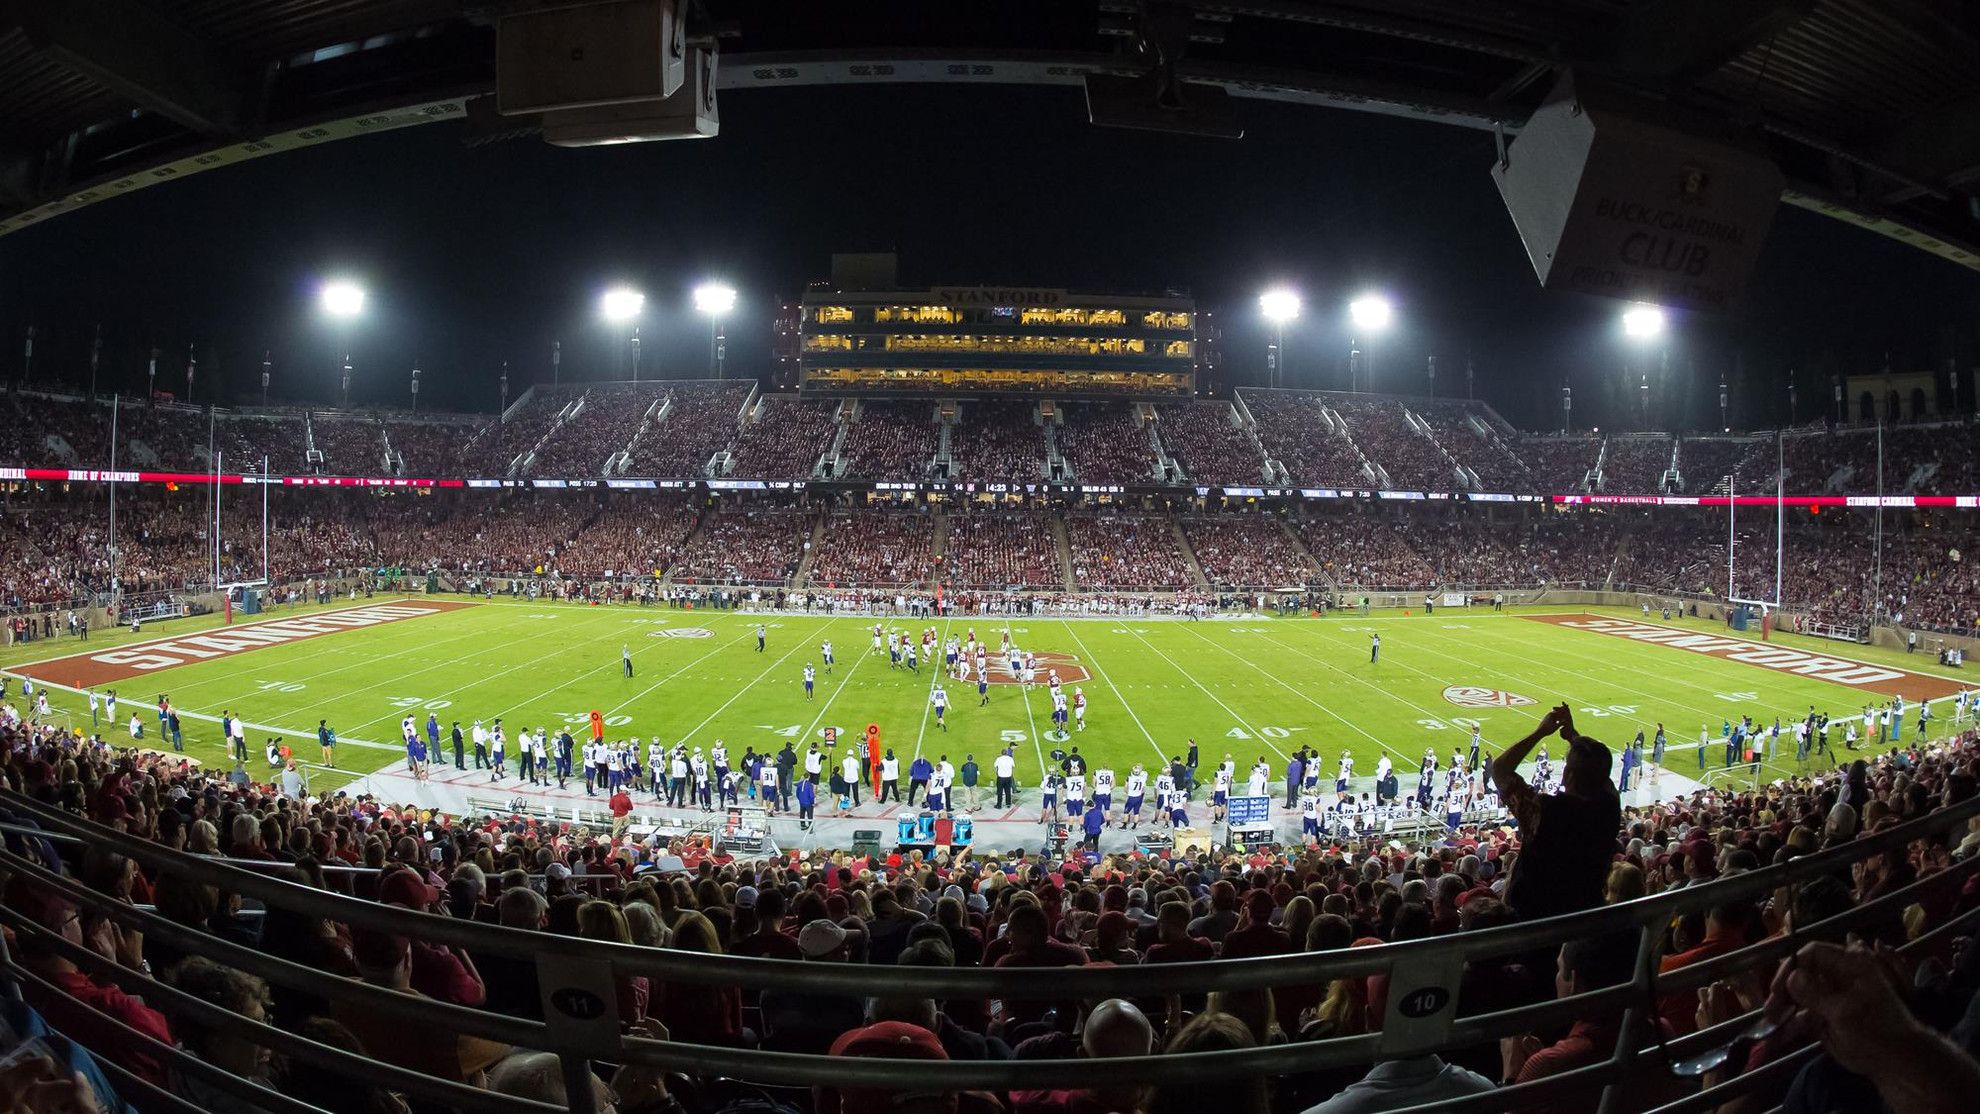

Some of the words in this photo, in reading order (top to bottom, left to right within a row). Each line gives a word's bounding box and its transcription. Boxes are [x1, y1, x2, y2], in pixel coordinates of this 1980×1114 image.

[1595, 198, 1747, 246] BUCK/CARDINAL
[1620, 232, 1711, 276] CLUB
[940, 289, 1059, 304] STANFORD
[68, 470, 88, 481] HOME
[90, 471, 98, 482] OF
[100, 471, 140, 482] CHAMPIONS
[90, 605, 443, 670] STANFORD
[1559, 620, 1906, 685] STANFORD
[826, 728, 836, 740] 2
[763, 772, 773, 781] 31
[1099, 775, 1111, 785] 58
[1070, 782, 1082, 791] 75
[1133, 781, 1142, 791] 71
[1158, 781, 1170, 790] 46
[1433, 802, 1445, 812] 47
[568, 996, 589, 1014] 11
[1414, 993, 1436, 1012] 10
